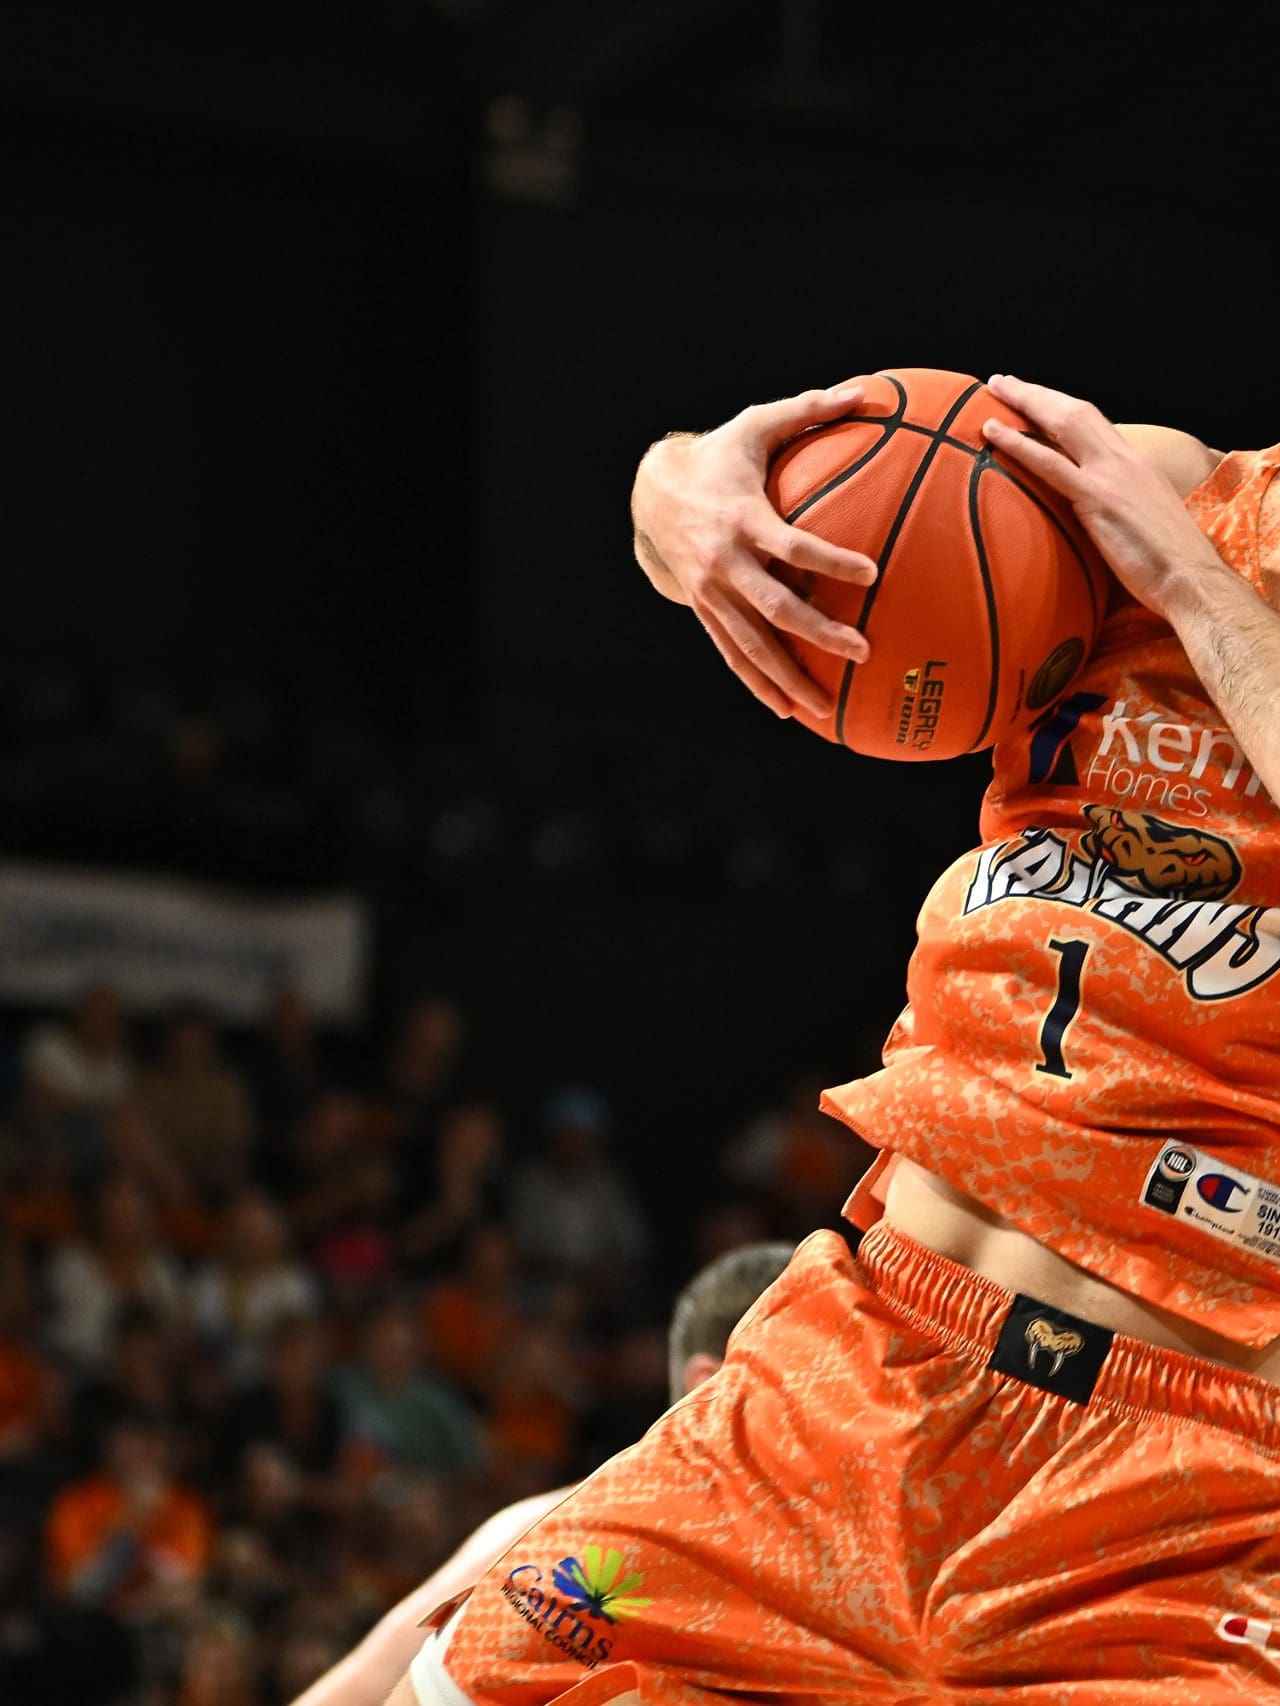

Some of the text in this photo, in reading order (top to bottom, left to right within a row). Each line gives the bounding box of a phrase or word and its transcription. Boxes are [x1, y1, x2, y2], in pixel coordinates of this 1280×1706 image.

[911, 661, 947, 750] LEGACY
[1097, 701, 1262, 797] Ken
[1086, 757, 1213, 818] Homes
[1035, 937, 1091, 1079] 1
[1167, 1152, 1191, 1173] NBL
[501, 1582, 599, 1670] REGIONAL COUNCIL
[509, 1564, 614, 1661] Cairns
